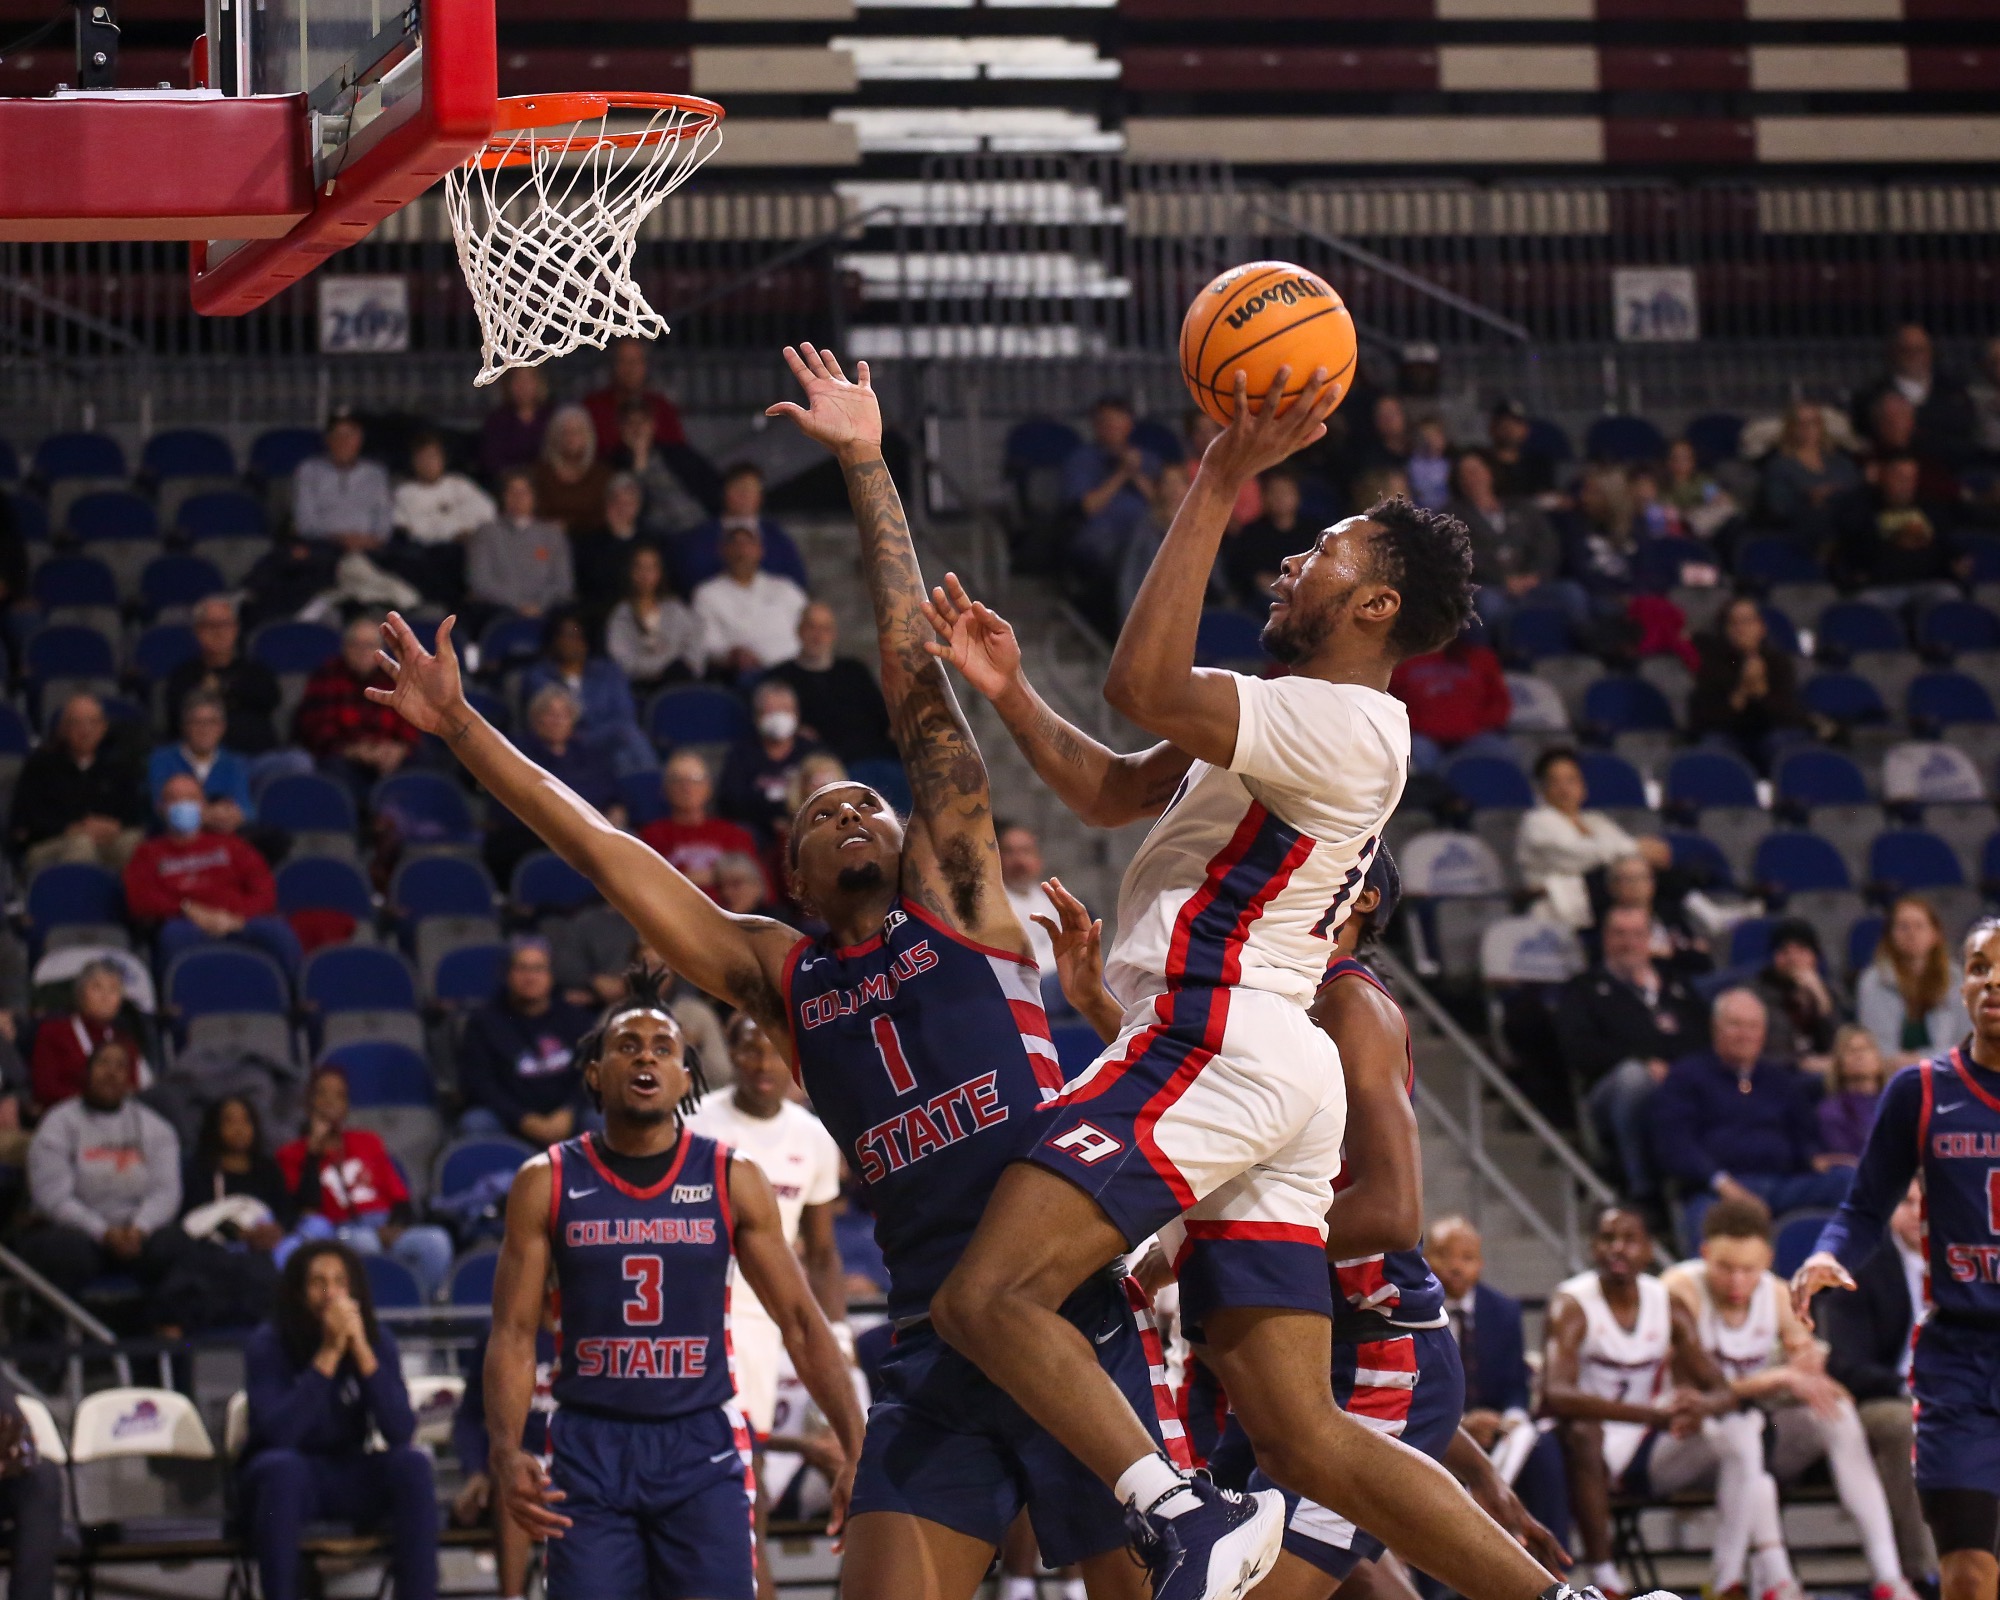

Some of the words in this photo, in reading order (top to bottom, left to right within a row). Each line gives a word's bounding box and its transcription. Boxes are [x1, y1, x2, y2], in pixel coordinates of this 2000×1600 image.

[1225, 275, 1331, 330] Wilson
[870, 1012, 918, 1096] 1
[855, 1069, 1009, 1185] STATE
[1044, 1118, 1126, 1168] A
[565, 1218, 716, 1247] COLUMBUS
[1946, 1243, 2000, 1284] ST
[622, 1254, 663, 1327] 3
[576, 1336, 709, 1378] STATE
